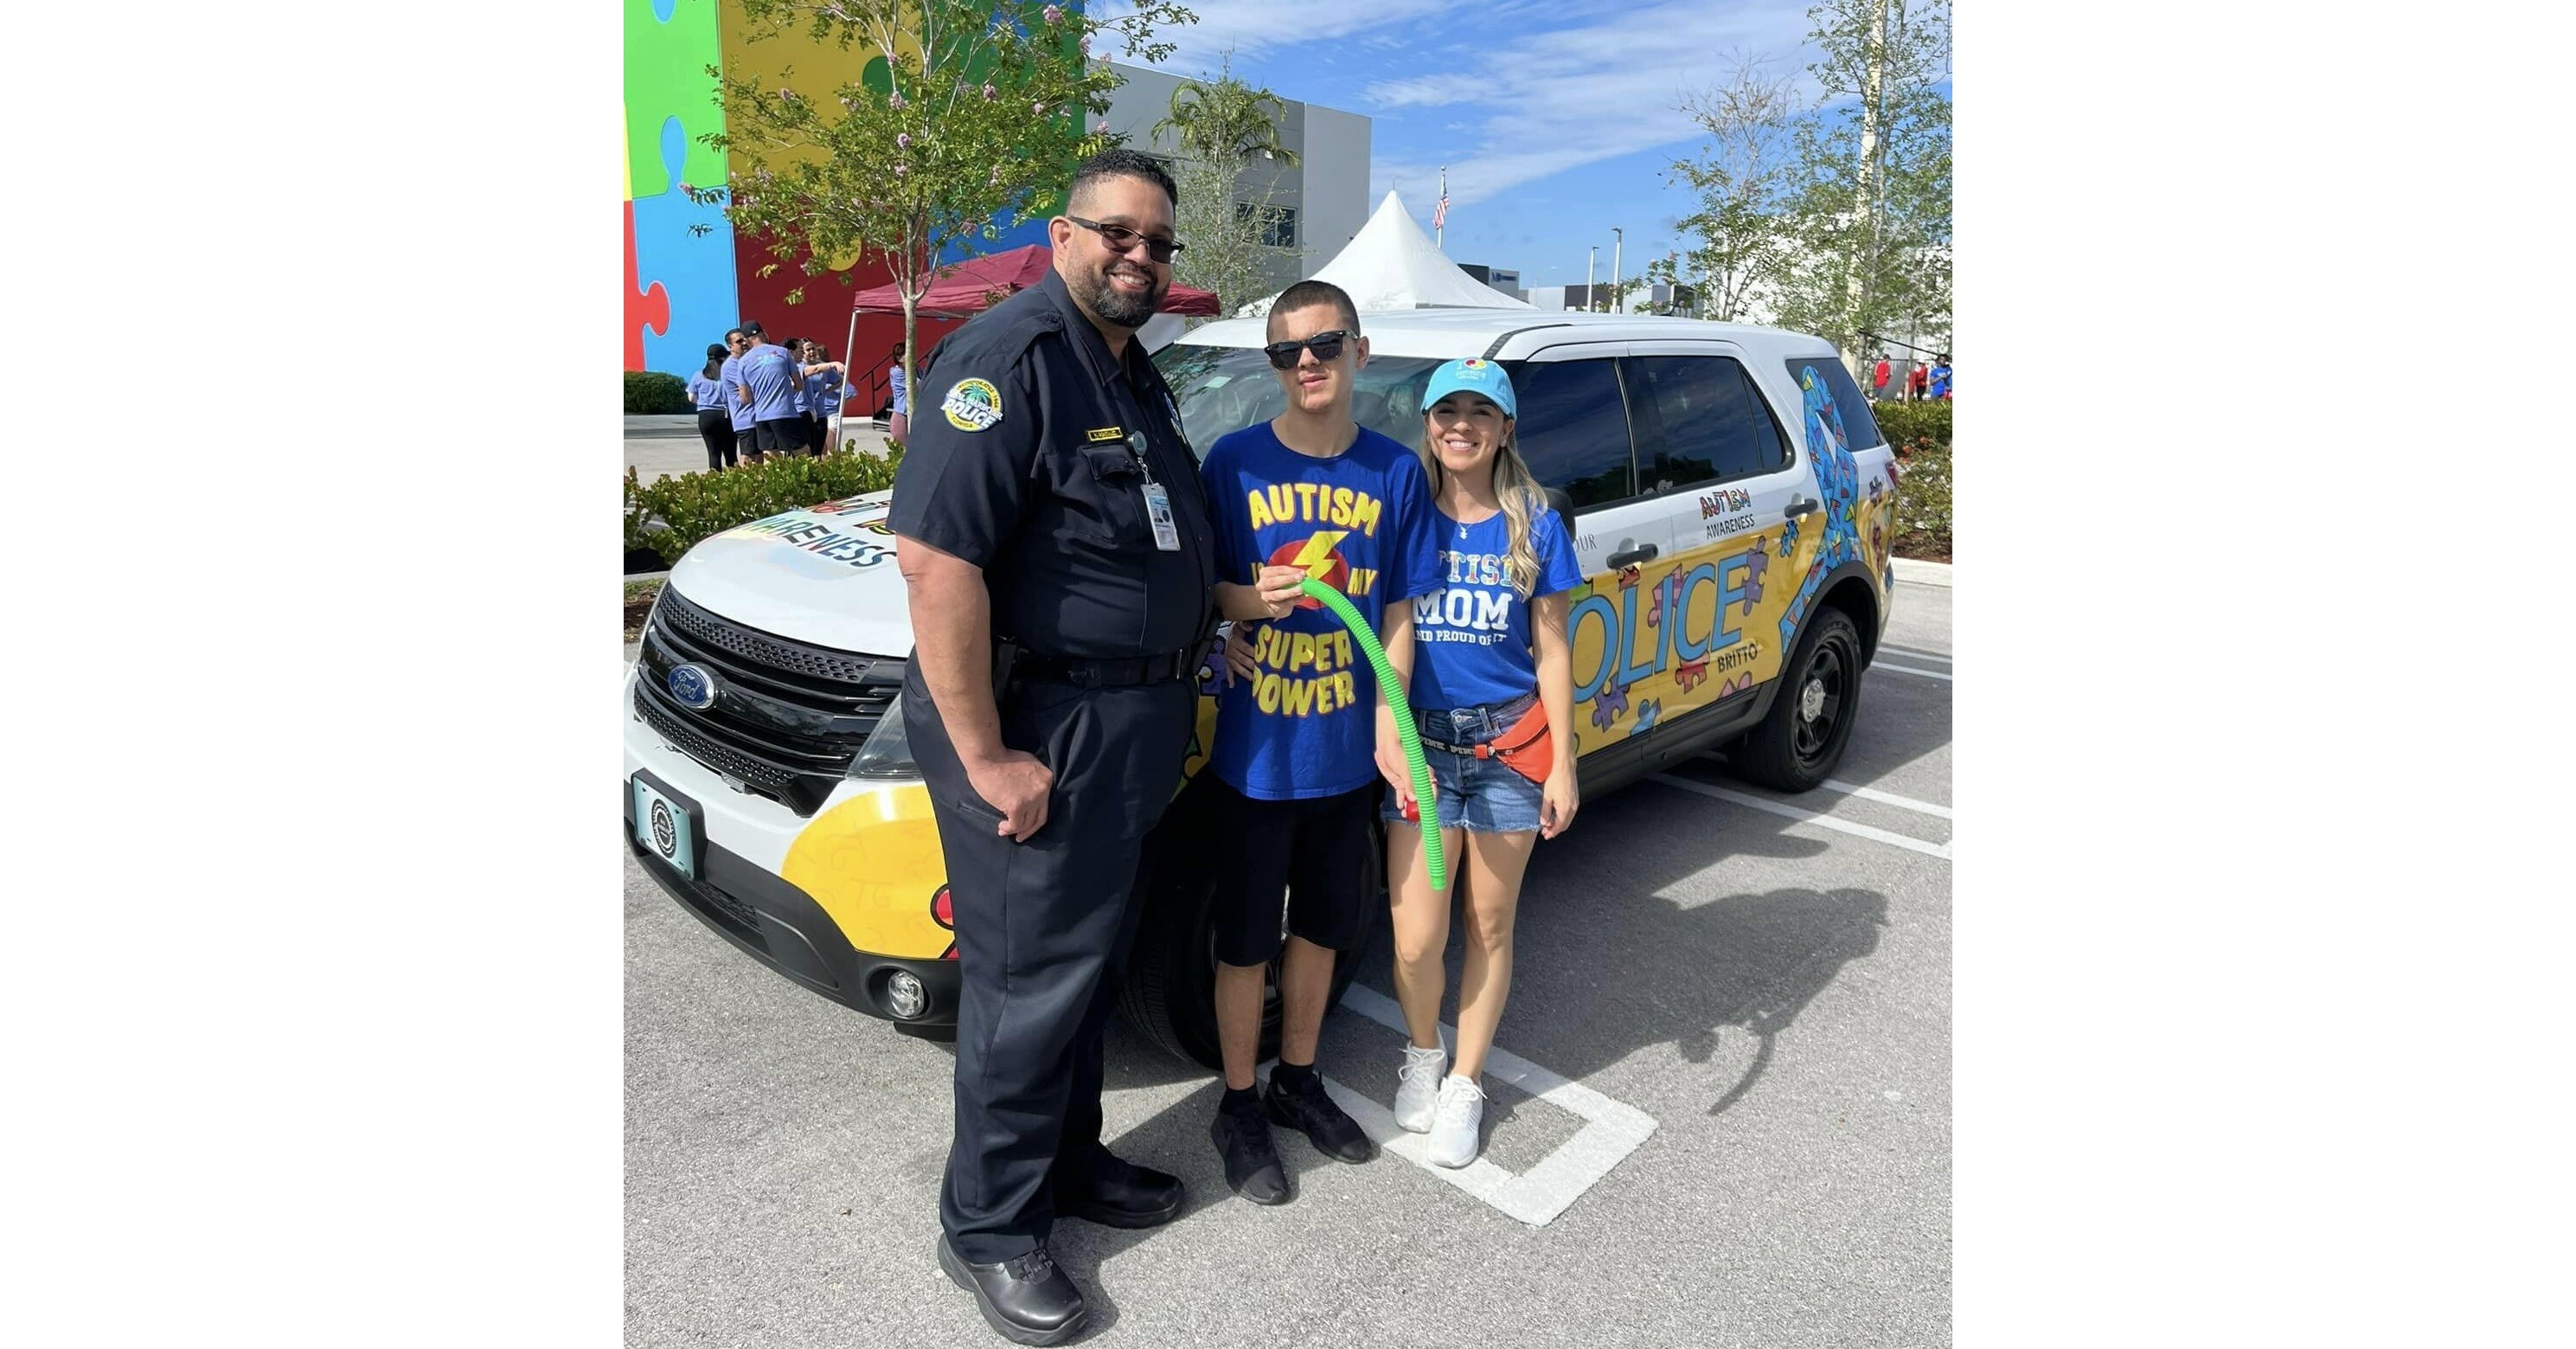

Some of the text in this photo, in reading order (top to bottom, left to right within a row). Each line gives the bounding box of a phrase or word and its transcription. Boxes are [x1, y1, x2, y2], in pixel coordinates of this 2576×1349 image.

[940, 398, 996, 429] POLICE
[1248, 483, 1381, 536] AUTISM
[1699, 488, 1752, 520] AUTISM
[1706, 514, 1755, 540] AWARENESS
[1347, 568, 1379, 595] MY
[1412, 588, 1513, 630] MOM
[1414, 630, 1433, 641] ND
[1435, 630, 1476, 644] PROUD
[1567, 552, 1749, 703] OLICE
[1254, 624, 1355, 673] SUPER
[1718, 642, 1758, 673] BRITTO
[674, 670, 700, 700] Ford
